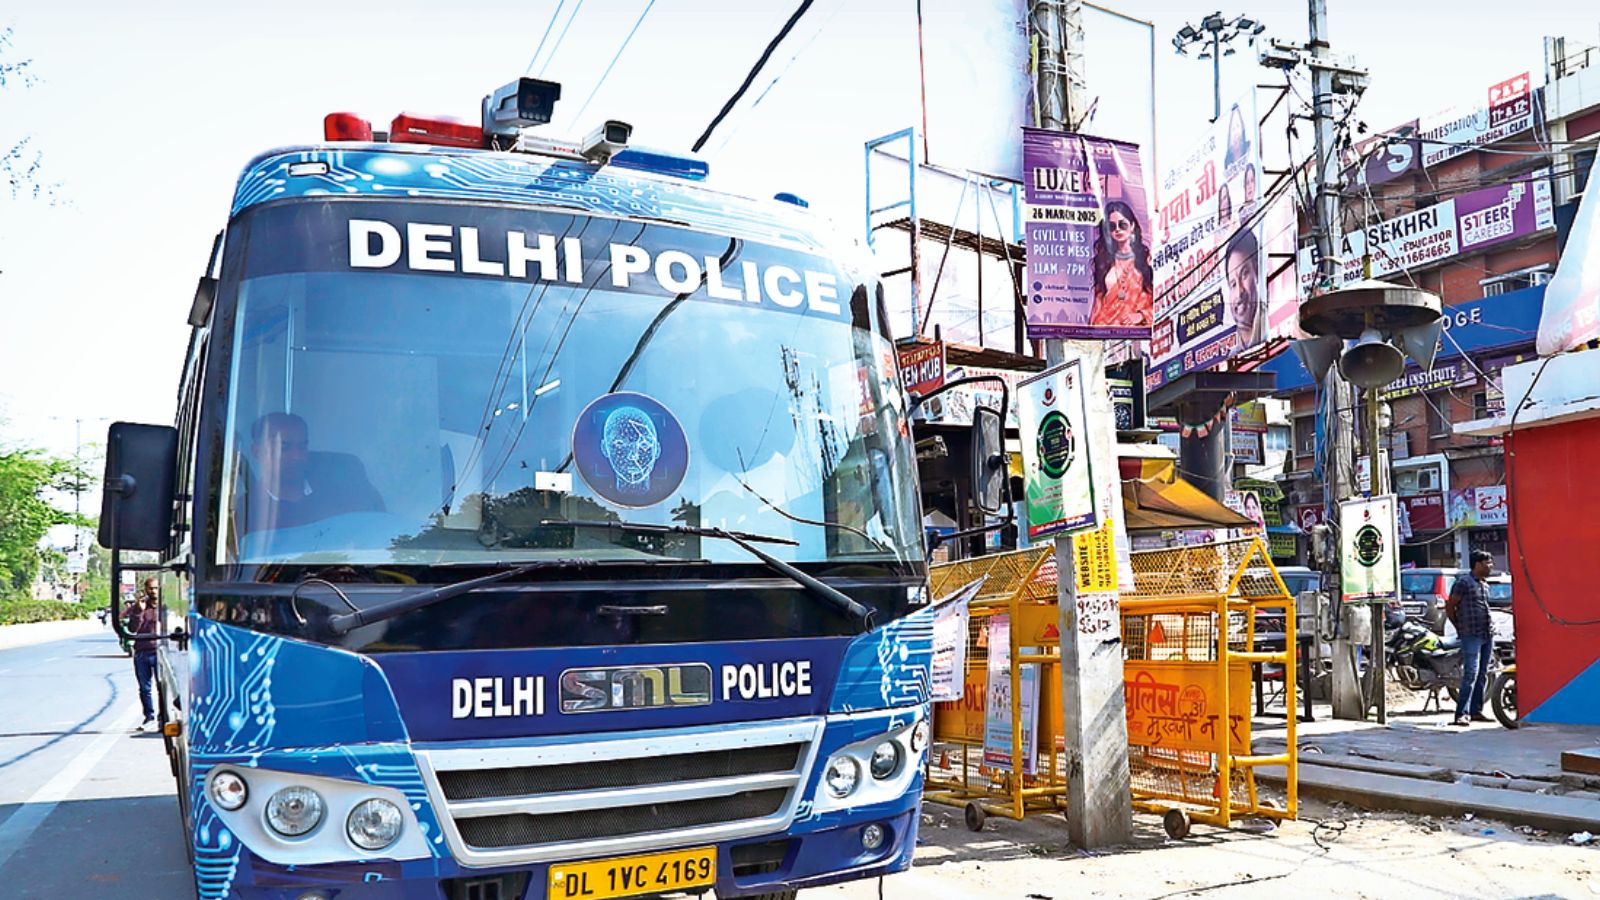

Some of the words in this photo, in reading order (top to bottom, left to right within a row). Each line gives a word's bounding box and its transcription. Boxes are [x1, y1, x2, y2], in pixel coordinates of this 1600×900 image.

[1509, 118, 1528, 133] CLAT
[1036, 168, 1079, 192] LUXE
[1196, 159, 1217, 206] जी
[1033, 207, 1043, 219] 26
[1045, 208, 1075, 221] MARCH
[1077, 210, 1097, 222] 2025
[1464, 206, 1510, 231] STEER
[1033, 229, 1058, 241] CIVIL
[1368, 208, 1438, 247] SEKHRI
[1465, 220, 1512, 243] CAREERS
[1033, 244, 1064, 256] POLICE
[1068, 245, 1089, 258] MESS
[348, 219, 583, 284] DELHI
[609, 243, 841, 316] POLICE
[1066, 263, 1086, 275] 7PM
[921, 357, 941, 382] HUB
[1078, 544, 1091, 588] WEBSITE
[721, 660, 812, 700] POLICE
[452, 675, 545, 719] DELHI
[565, 872, 593, 897] DL
[608, 864, 648, 891] 1VC
[655, 857, 711, 885] 4169
